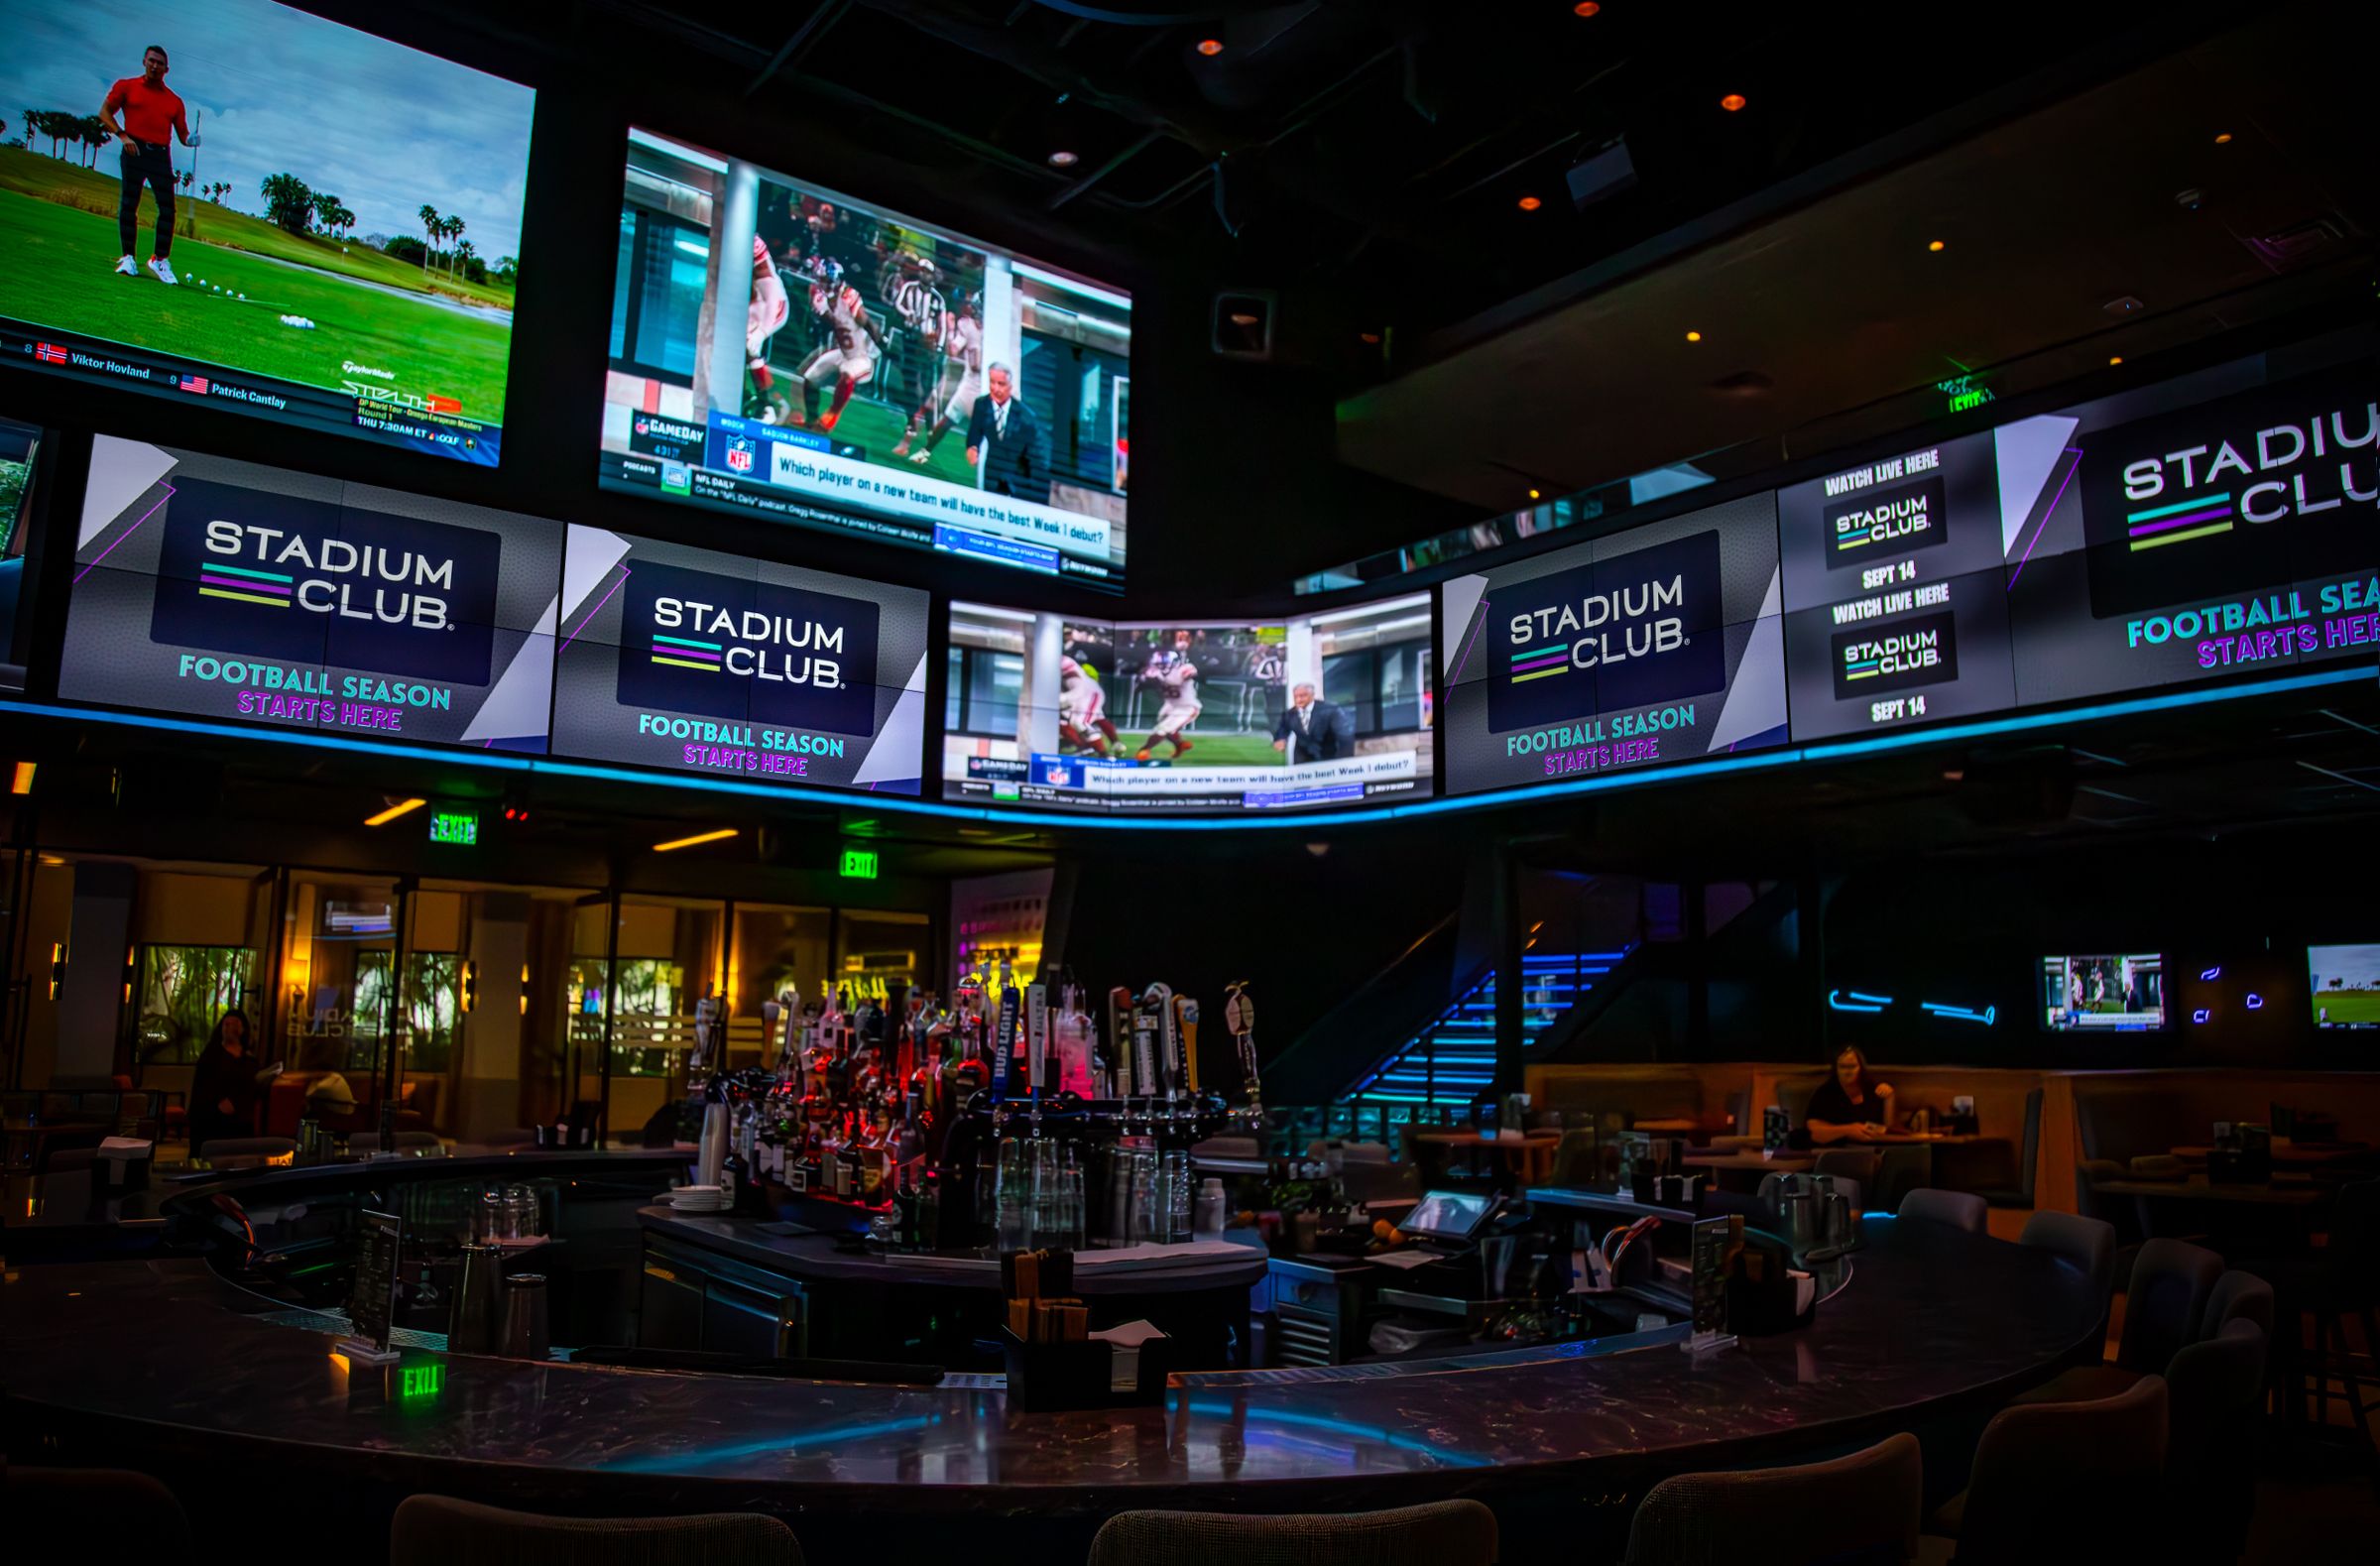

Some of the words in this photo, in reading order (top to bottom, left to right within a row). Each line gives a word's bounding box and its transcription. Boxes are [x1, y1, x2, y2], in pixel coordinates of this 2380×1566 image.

[25, 343, 33, 353] 8
[71, 352, 104, 370] Viktor
[106, 360, 150, 379] Hovland
[170, 375, 178, 385] 9
[211, 383, 247, 401] Patrick
[248, 391, 286, 410] Cantlay
[358, 407, 387, 420] Round
[369, 400, 388, 412] World
[1954, 391, 1980, 412] EXIT
[357, 416, 378, 428] THU
[415, 427, 428, 439] ET
[729, 448, 752, 468] NFL
[1825, 466, 1874, 497] WATCH
[1875, 458, 1904, 484] LIVE
[1905, 448, 1940, 478] HERE
[2123, 402, 2380, 501] STADIU
[779, 457, 815, 478] Which
[818, 468, 854, 487] player
[857, 479, 871, 491] on
[874, 483, 881, 493] a
[884, 484, 907, 498] new
[909, 489, 938, 506] team
[940, 497, 958, 511] will
[960, 501, 986, 518] have
[989, 506, 1006, 522] the
[1008, 511, 1031, 527] best
[1033, 517, 1060, 535] Week
[1070, 525, 1105, 543] debut?
[1836, 494, 1928, 534] STADIUM
[2239, 462, 2380, 524] CLU
[204, 520, 454, 591] STADIUM
[1861, 563, 1896, 590] SEPT
[1898, 558, 1917, 582] 14
[1510, 573, 1684, 645] STADIUM
[1832, 597, 1882, 626] WATCH
[1884, 590, 1913, 614] LIVE
[1915, 581, 1951, 607] HERE
[2127, 591, 2312, 649] FOOTBALL
[654, 597, 844, 655] STADIUM
[1844, 629, 1938, 663] STADIUM
[2197, 622, 2319, 668] STARTS
[178, 654, 333, 696] FOOTBALL
[342, 676, 451, 712] SEASON
[236, 689, 336, 724] STARTS
[339, 703, 403, 732] HERE
[1506, 719, 1606, 758] FOOTBALL
[1611, 703, 1696, 739] SEASON
[1870, 699, 1906, 724] SEPT
[1907, 694, 1926, 717] 14
[639, 713, 756, 748] FOOTBALL
[761, 728, 845, 759] SEASON
[1544, 744, 1610, 777] STARTS
[1612, 736, 1660, 767] HERE
[683, 743, 758, 772] STARTS
[761, 753, 809, 778] HERE
[1092, 774, 1125, 784] Which
[1128, 775, 1161, 785] player
[1164, 776, 1178, 784] on
[1217, 775, 1247, 783] team
[1249, 774, 1267, 783] will
[1269, 772, 1295, 783] have
[1296, 770, 1312, 782] the
[1338, 765, 1366, 777] Week
[1373, 759, 1409, 773] debut?
[438, 813, 473, 843] EXIT
[845, 851, 874, 878] EXIT
[999, 1001, 1014, 1045] LIGHT
[994, 1046, 1009, 1078] BUD
